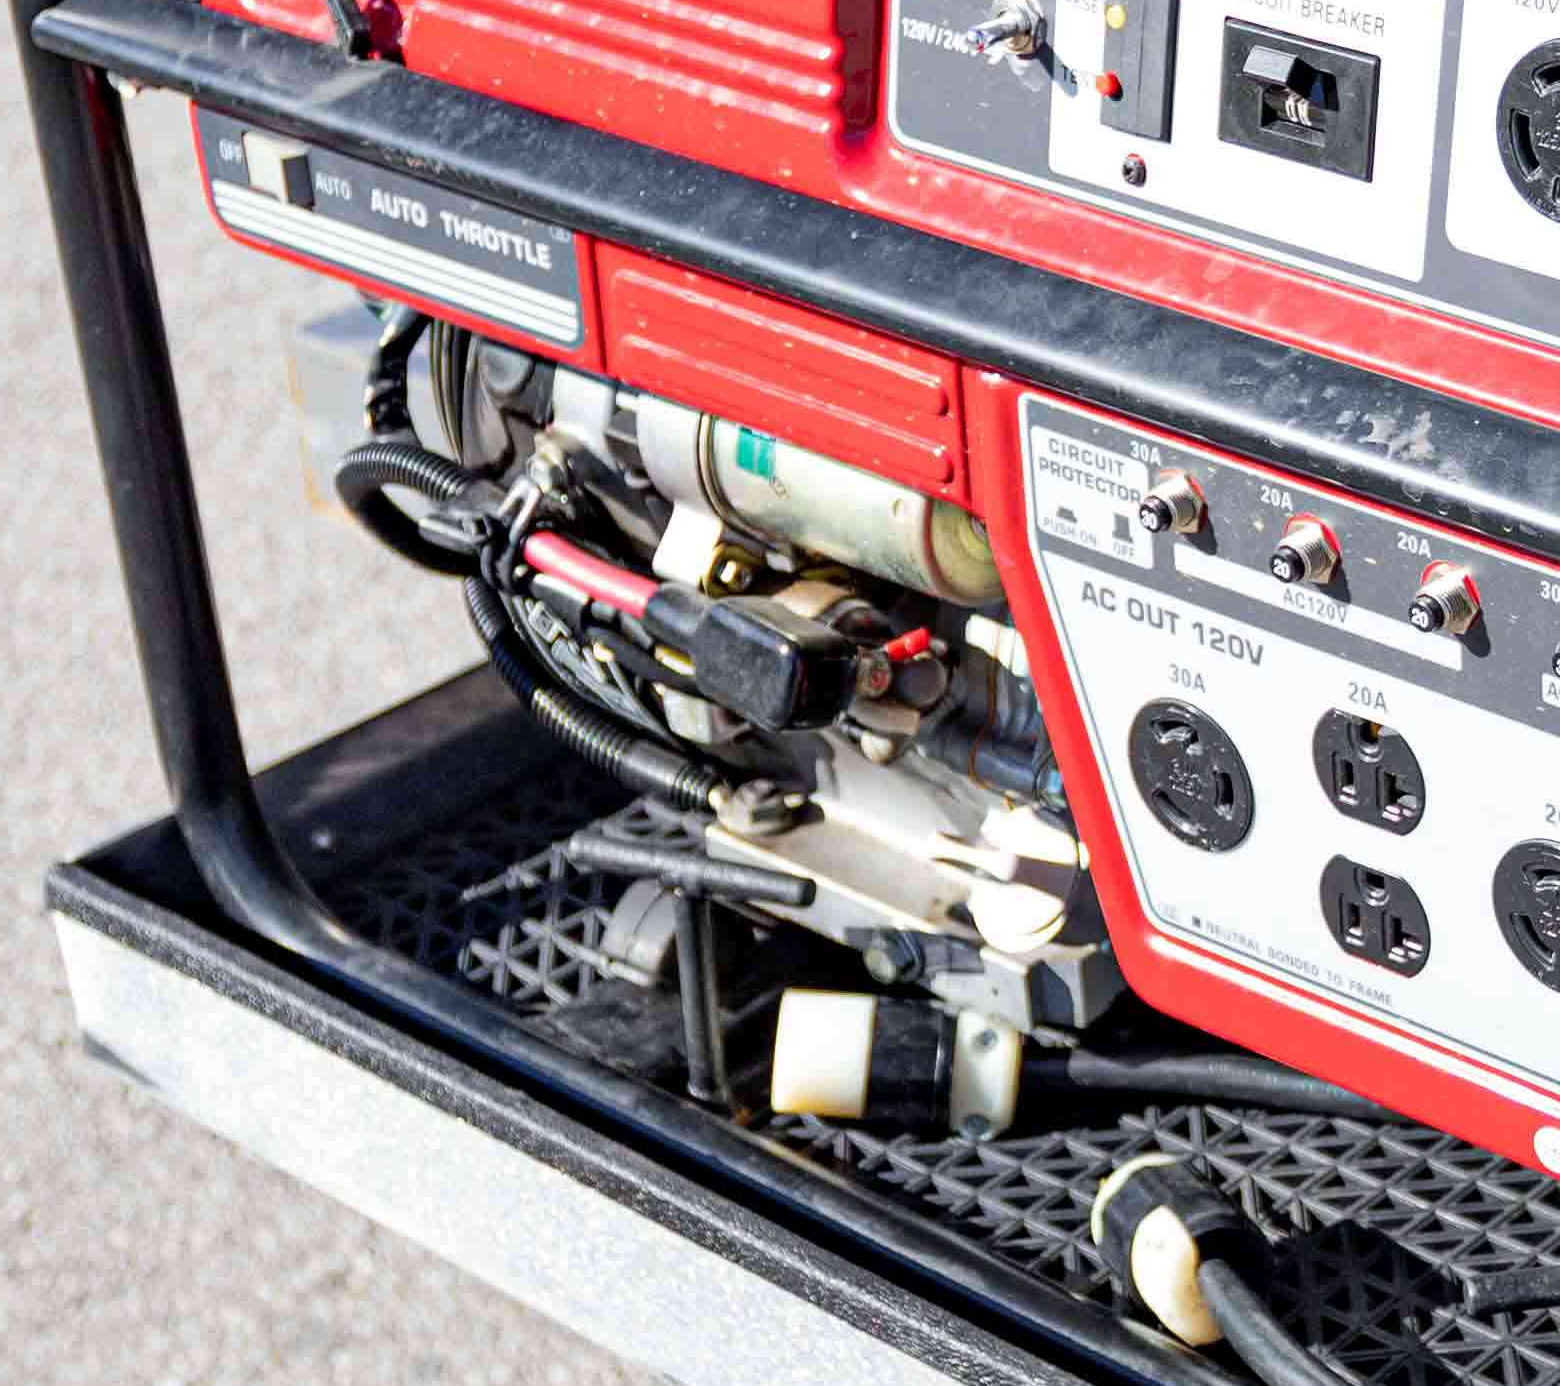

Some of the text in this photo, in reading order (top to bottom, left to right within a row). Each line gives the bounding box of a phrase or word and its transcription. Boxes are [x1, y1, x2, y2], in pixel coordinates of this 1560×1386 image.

[314, 173, 352, 201] AUTO
[370, 188, 429, 229] AUTO
[439, 212, 553, 270] THROTTLE
[1047, 437, 1125, 479] CIRCUIT
[1128, 439, 1161, 466] 30A
[1038, 456, 1141, 503] PROTECTOR
[1259, 485, 1294, 511] 20A
[1396, 531, 1432, 559] 20A
[1271, 557, 1291, 579] 20
[1282, 588, 1348, 625] AC120V
[1410, 607, 1430, 630] 20
[1080, 581, 1265, 667] AC OUT 120V
[1168, 663, 1208, 694] 30A
[1347, 681, 1389, 713] 20A
[1205, 921, 1393, 1007] NEUTRAL BONDED TO FRAME
